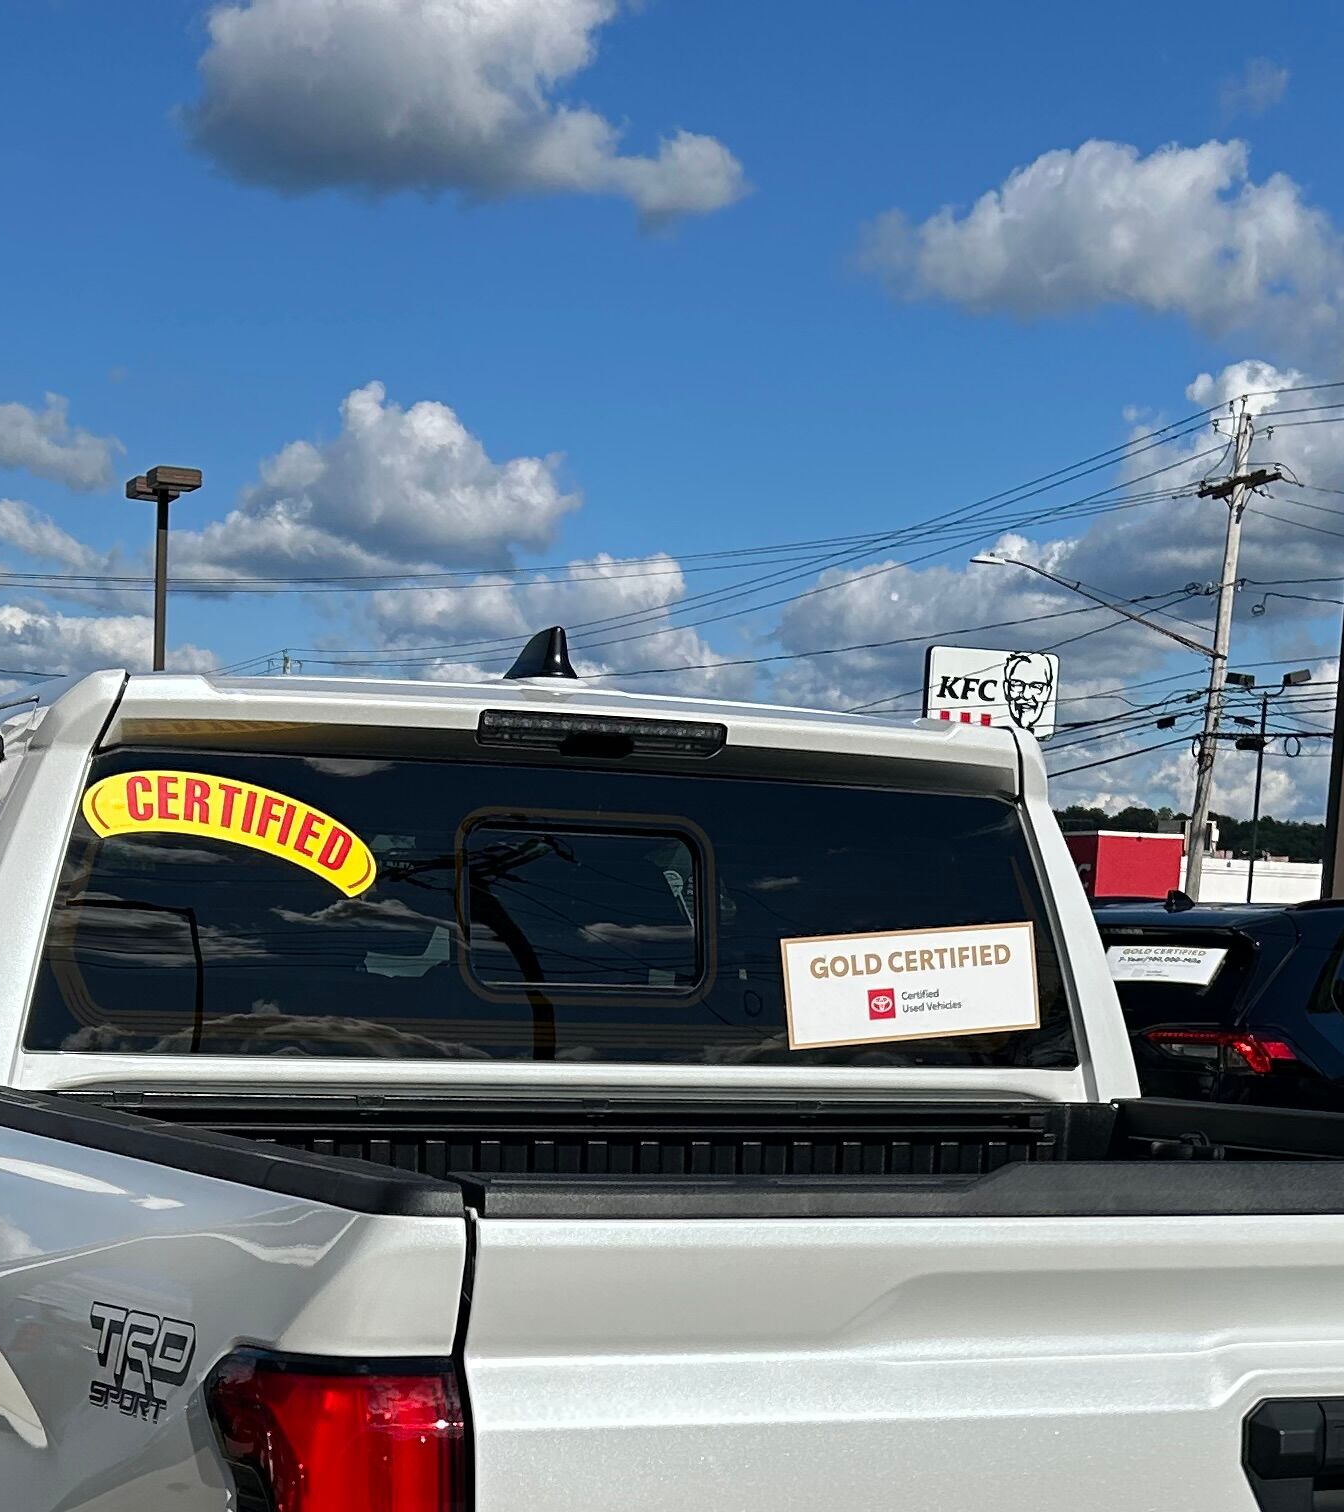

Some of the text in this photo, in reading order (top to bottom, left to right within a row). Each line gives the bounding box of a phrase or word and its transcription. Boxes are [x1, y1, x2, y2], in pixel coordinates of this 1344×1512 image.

[936, 675, 998, 702] KFC
[126, 775, 354, 872] CERTIFIED
[810, 943, 1012, 980] GOLD CERTIFIED
[901, 988, 940, 1001] Certified
[902, 1000, 963, 1014] Used Vehicles
[90, 1301, 197, 1398] TRD
[89, 1380, 168, 1424] SPORT
